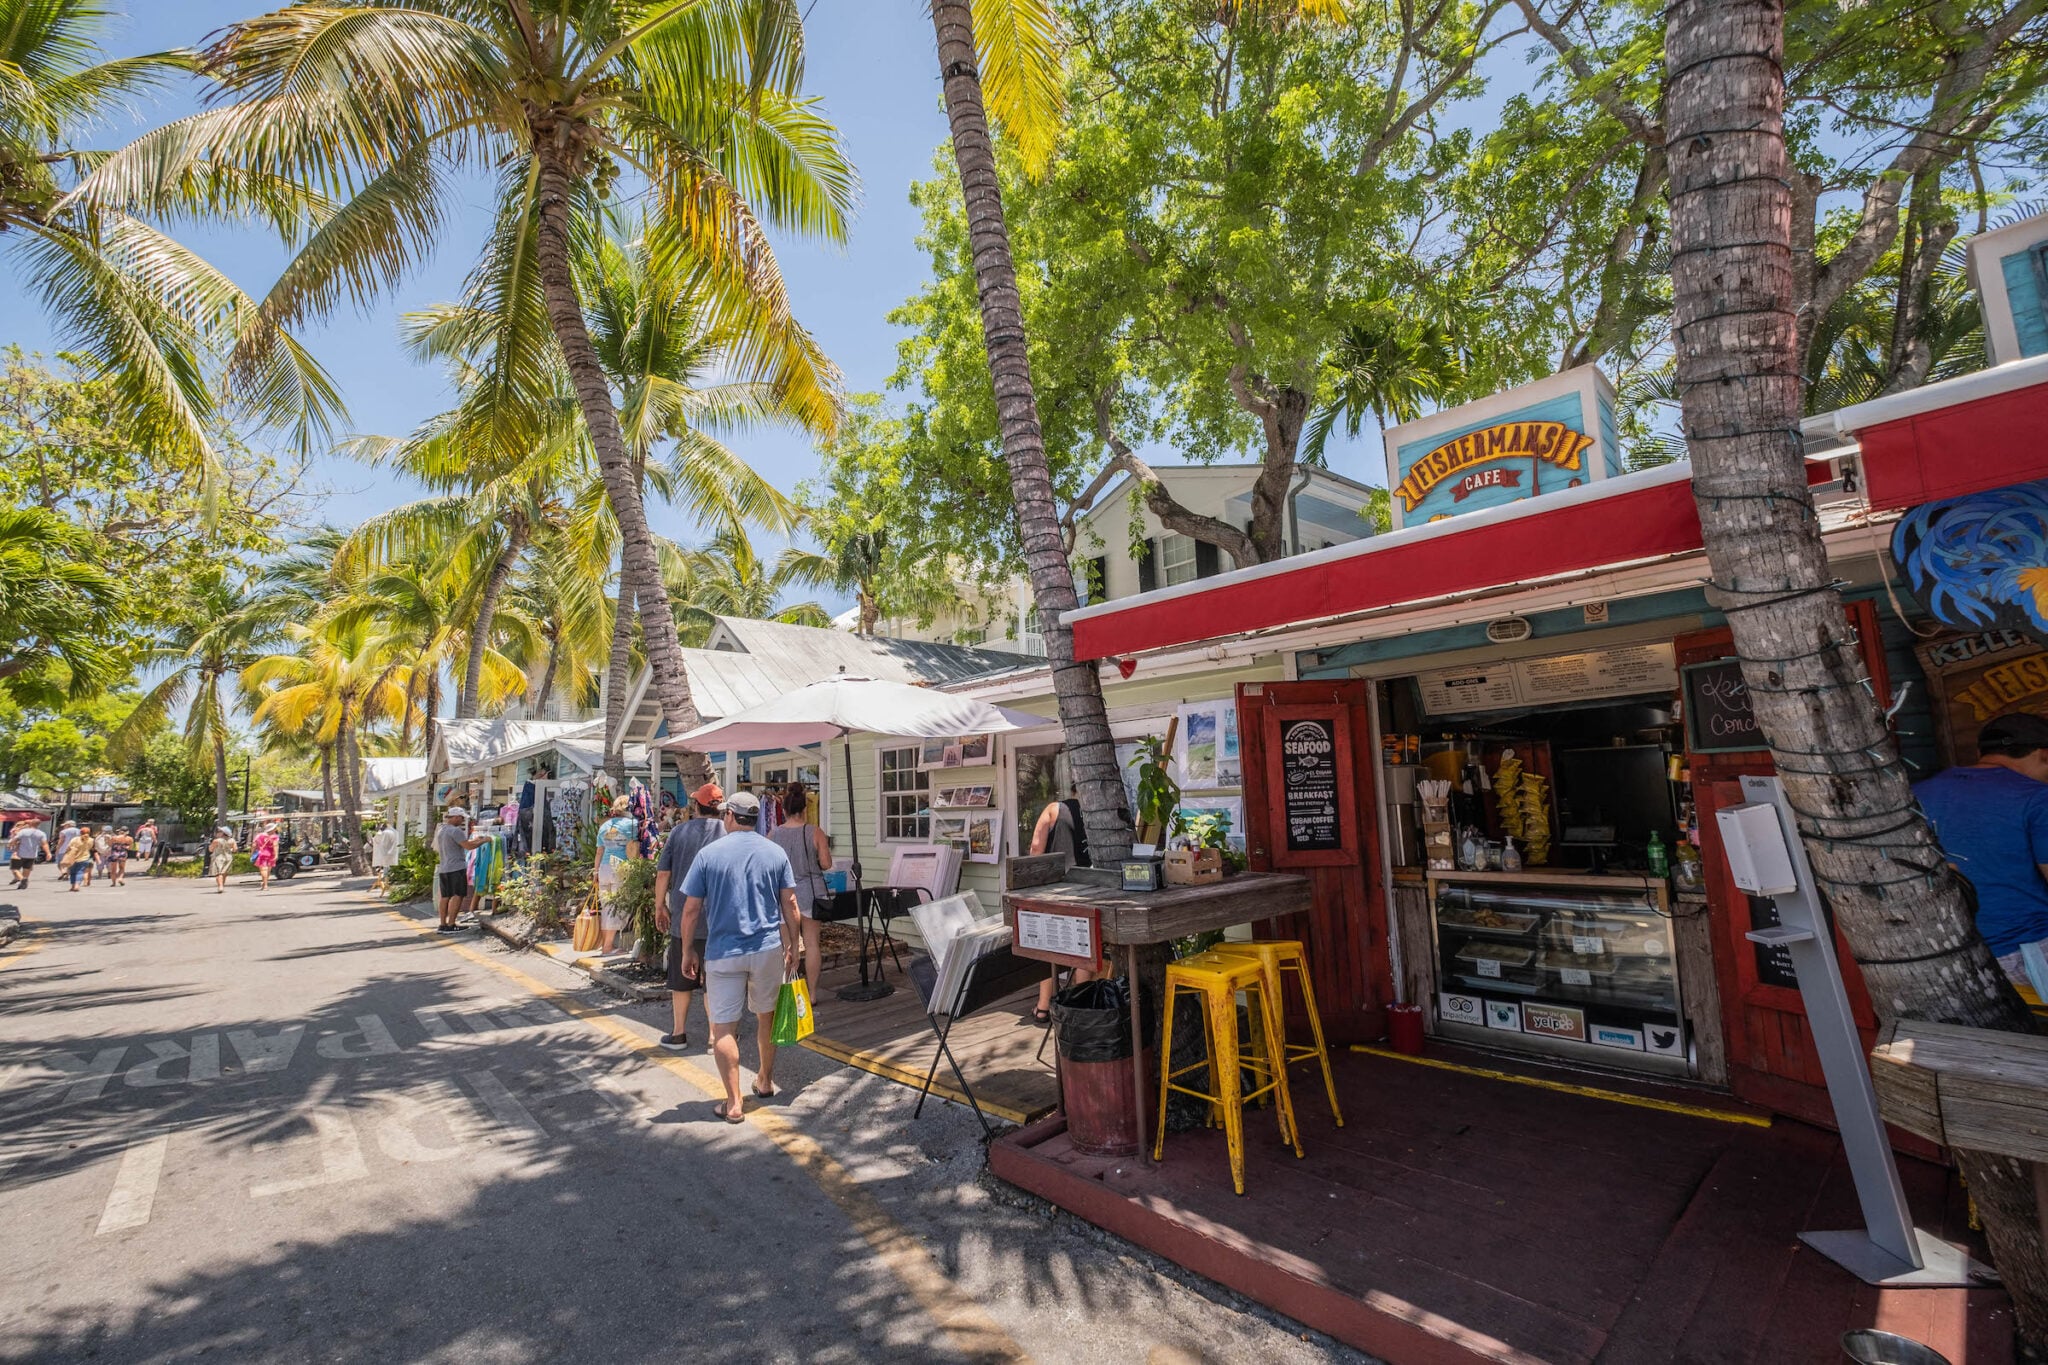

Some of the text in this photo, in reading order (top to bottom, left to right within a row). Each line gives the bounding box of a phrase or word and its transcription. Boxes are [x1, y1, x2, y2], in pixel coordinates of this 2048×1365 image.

[1414, 424, 1558, 486] FISHERMANS
[1465, 469, 1502, 491] CAFE
[1928, 629, 2032, 667] KILLE
[1990, 655, 2048, 699] FIS
[1701, 671, 1753, 712] Key
[1284, 740, 1331, 755] SEAFOOD
[1288, 790, 1334, 800] BREAKFAST
[1290, 815, 1334, 825] CUBAN COFFEE
[1442, 1010, 1480, 1023] tripadvisor
[1533, 1016, 1560, 1031] yelp
